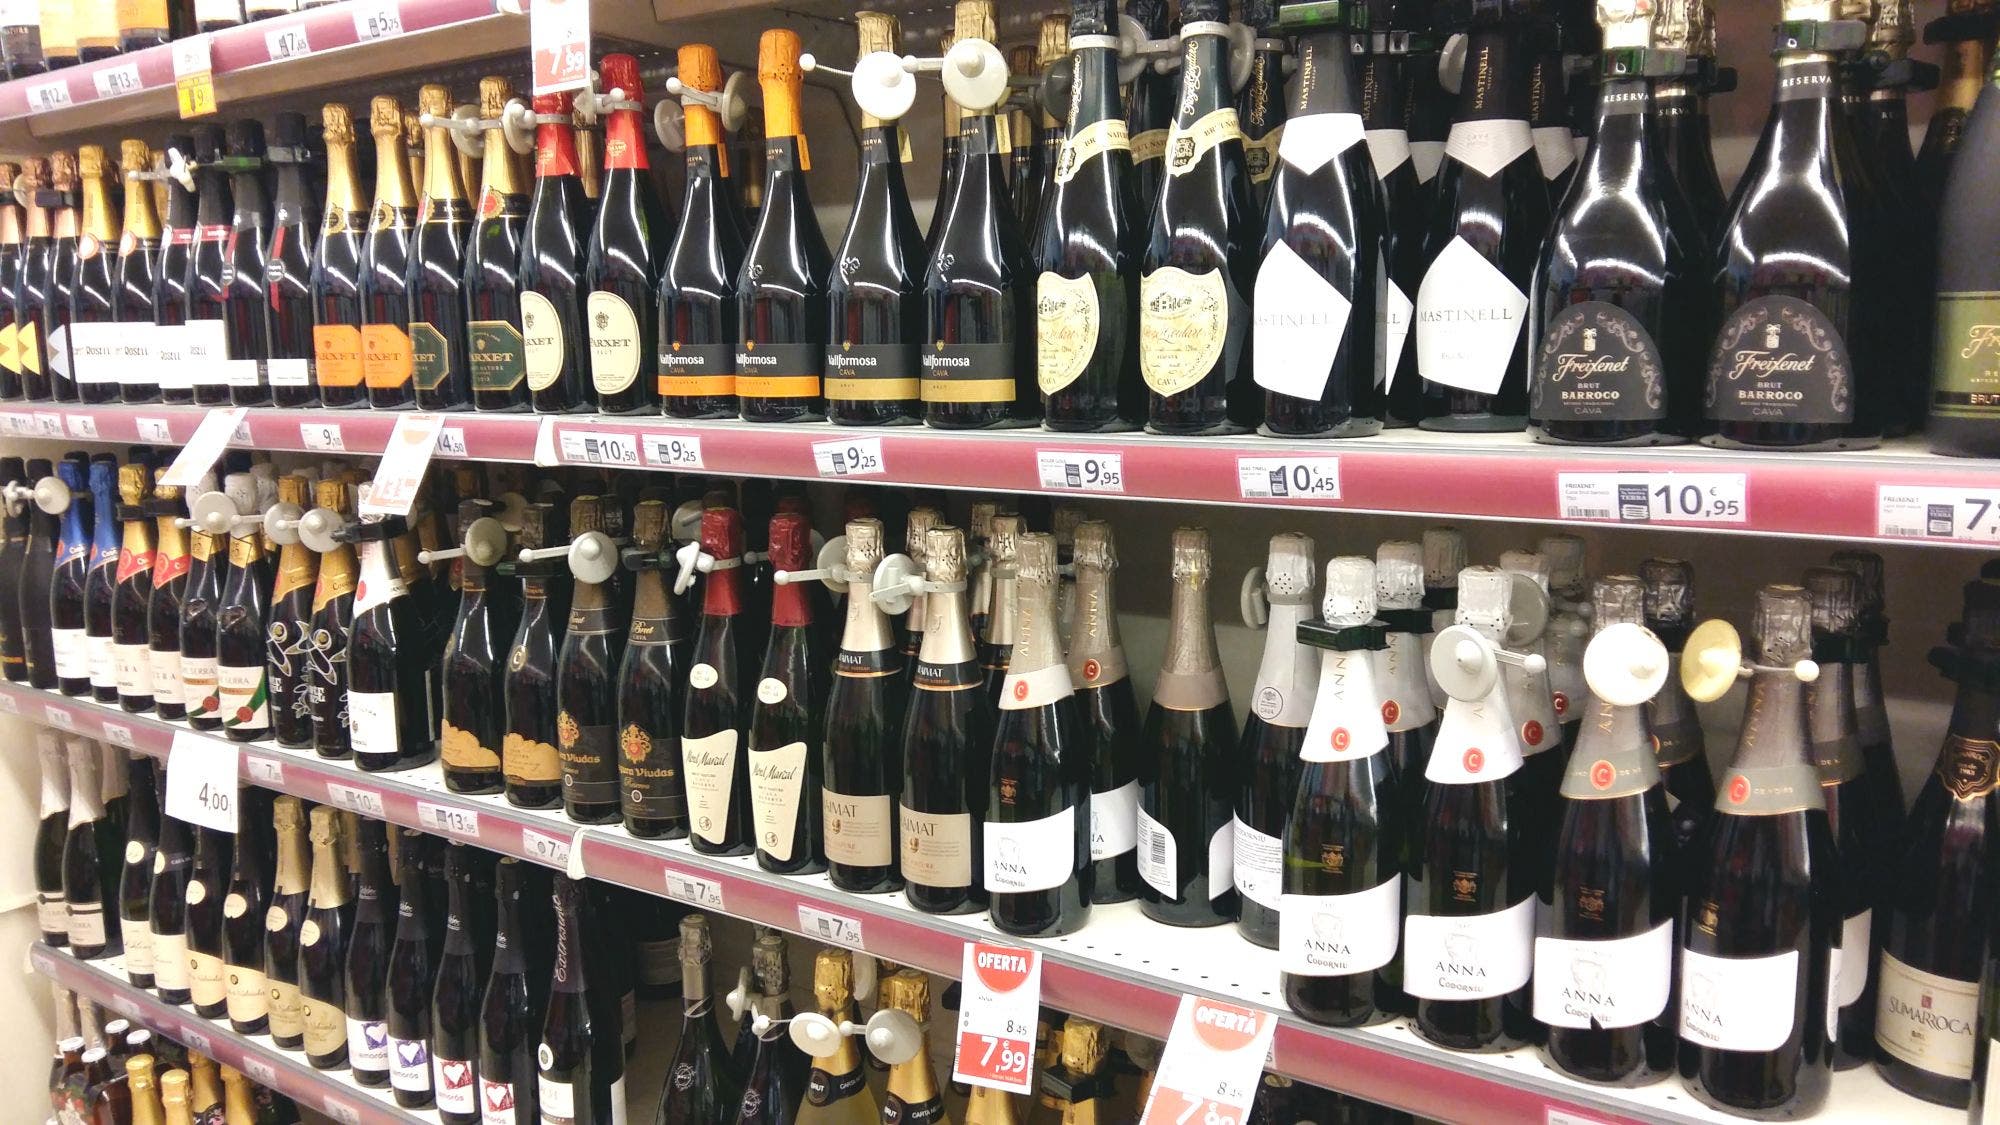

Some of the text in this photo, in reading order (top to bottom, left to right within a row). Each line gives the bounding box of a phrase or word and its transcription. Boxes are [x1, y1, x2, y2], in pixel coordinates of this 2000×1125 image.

[1300, 46, 1313, 110] MASTINELL
[1475, 46, 1489, 110] MASTINELL
[1782, 75, 1833, 88] RESERVA
[1604, 92, 1650, 103] RESERVA
[1253, 312, 1334, 327] ASTINELL
[1420, 308, 1513, 323] MASTINELL
[827, 353, 878, 369] Vallformosa
[922, 354, 970, 370] Vallformosa
[1552, 354, 1631, 382] Freixenet
[1728, 350, 1817, 380] Freixenet
[838, 368, 856, 376] CAVA
[932, 369, 950, 377] CAVA
[1757, 381, 1783, 389] BRUT
[1561, 390, 1620, 400] BARROCO
[1738, 390, 1803, 400] BARROCO
[1574, 407, 1602, 415] CAVA
[1752, 407, 1783, 416] CAVA
[600, 440, 636, 462] 10,50
[671, 440, 697, 462] 9,25
[847, 446, 877, 470] 9,25
[1084, 459, 1120, 485] 9,95
[1272, 464, 1335, 494] 10,45
[1654, 485, 1740, 517] 10,95
[566, 753, 601, 764] Viudas
[636, 767, 675, 777] Viudas
[198, 782, 229, 812] 4,00
[901, 818, 940, 837] AIMAT
[992, 860, 1027, 876] ANNA
[696, 882, 721, 905] 7,95
[832, 918, 860, 943] 7,95
[1304, 938, 1351, 956] ANNA
[977, 951, 1028, 974] OFERTA
[1435, 960, 1487, 978] ANNA
[1561, 986, 1616, 1008] ANNA
[1195, 1005, 1257, 1036] OFERTA
[1684, 998, 1724, 1027] ANNA
[1888, 996, 1973, 1036] SUMARROCA
[980, 1035, 1027, 1073] 7,99
[810, 1081, 825, 1092] BRUT
[883, 1106, 898, 1118] BRUT
